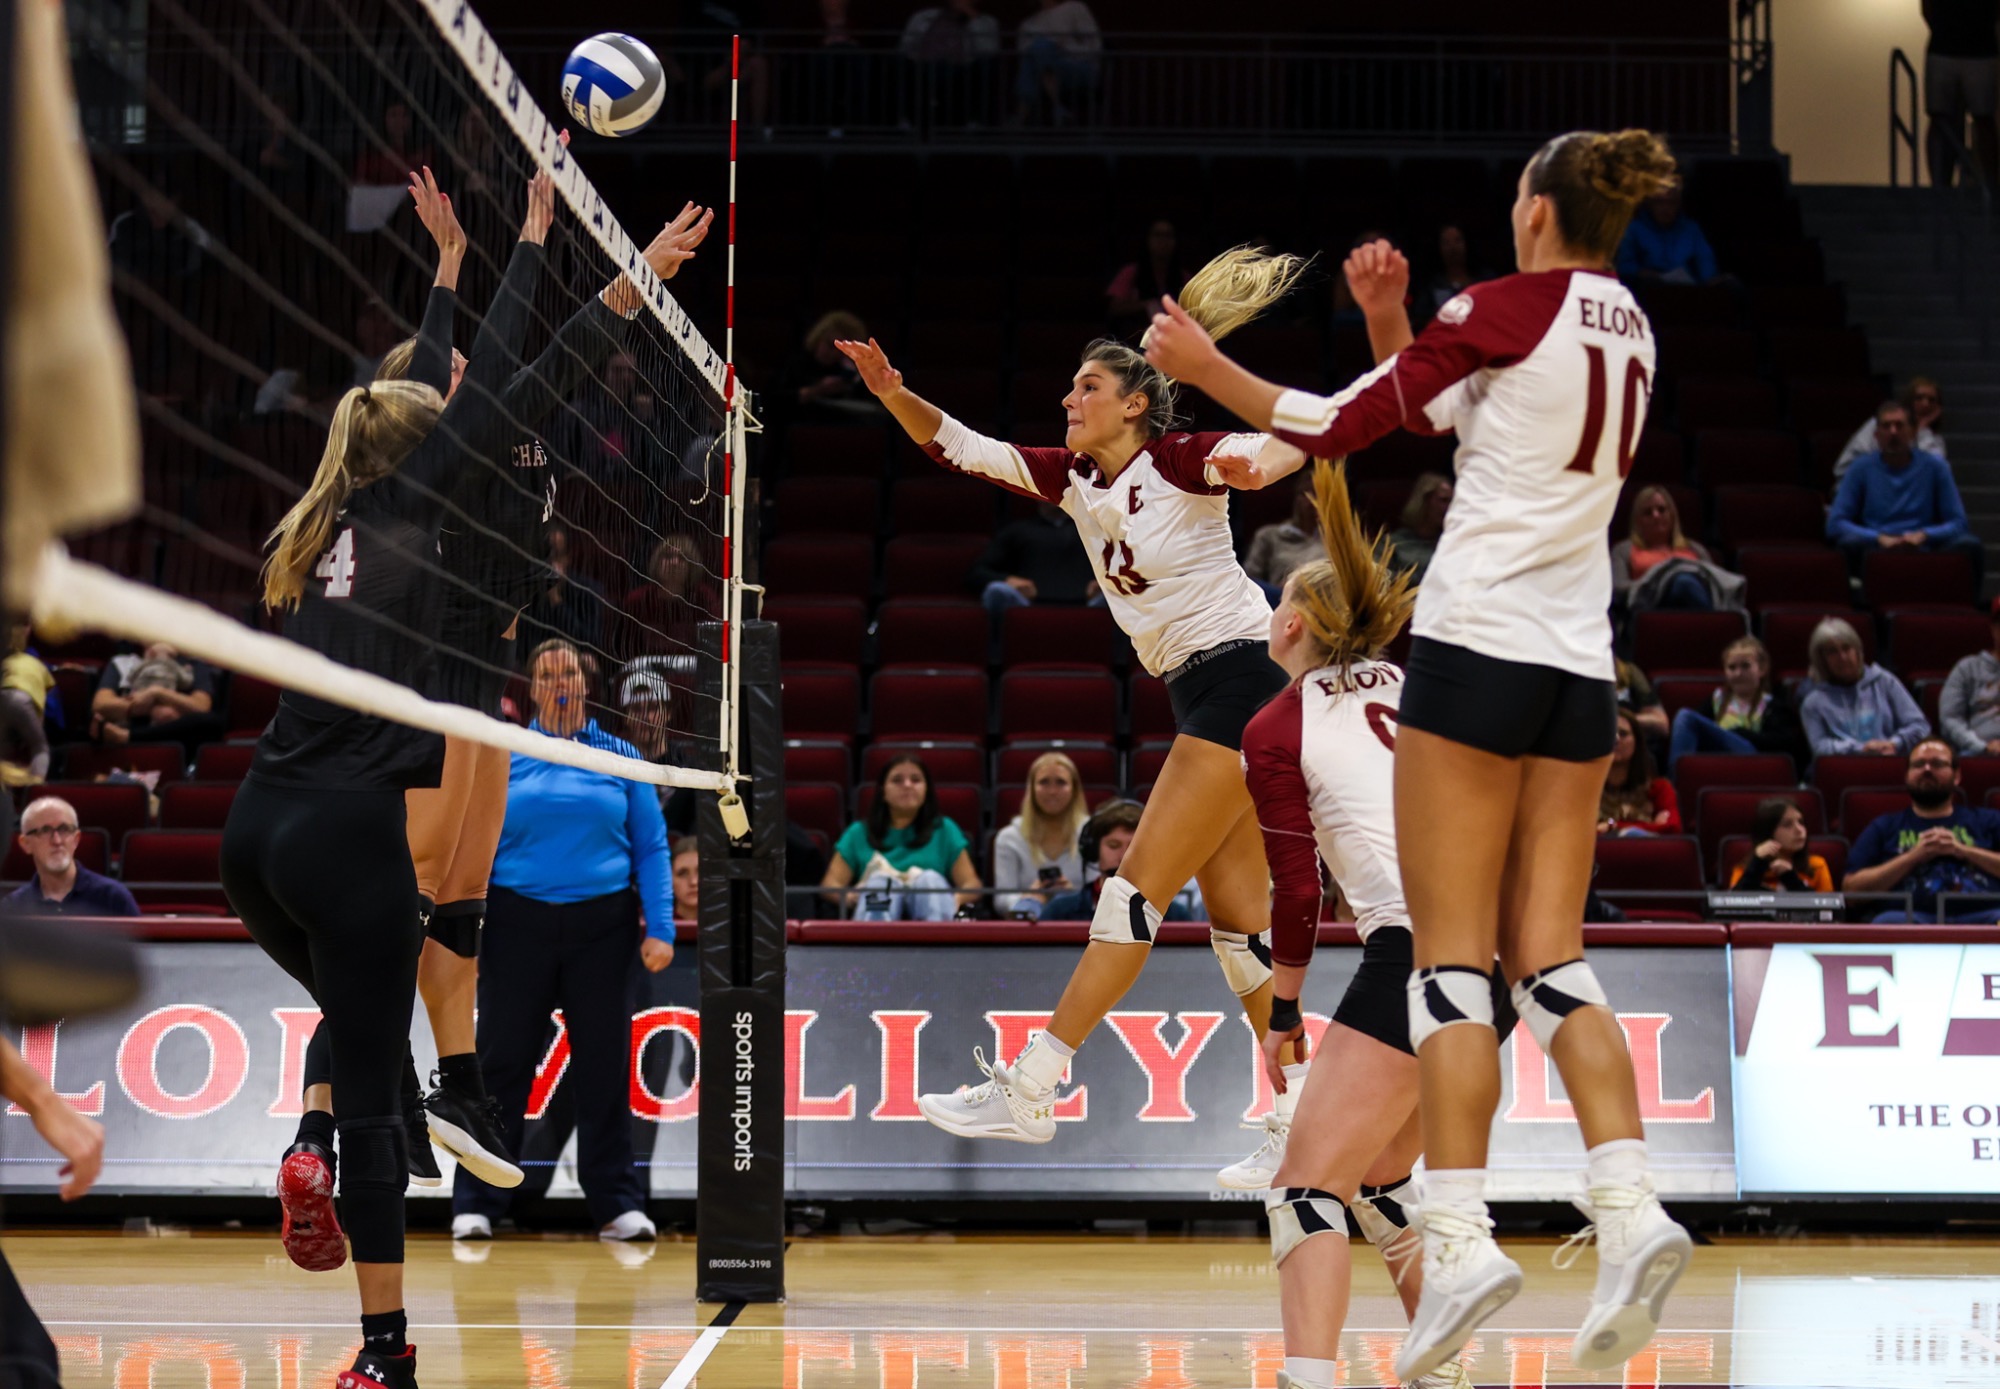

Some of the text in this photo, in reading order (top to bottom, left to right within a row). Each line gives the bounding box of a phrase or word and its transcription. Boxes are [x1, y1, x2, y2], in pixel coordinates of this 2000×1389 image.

[1578, 297, 1645, 340] ELON
[1563, 342, 1650, 480] 10
[1128, 485, 1144, 515] E
[315, 526, 358, 600] 4
[1101, 538, 1150, 596] 13
[1811, 952, 1901, 1049] E
[730, 1011, 755, 1172] sports imports
[1868, 1104, 2000, 1128] THE O
[1971, 1137, 2000, 1161] E
[708, 1258, 772, 1270] (800)556-3198
